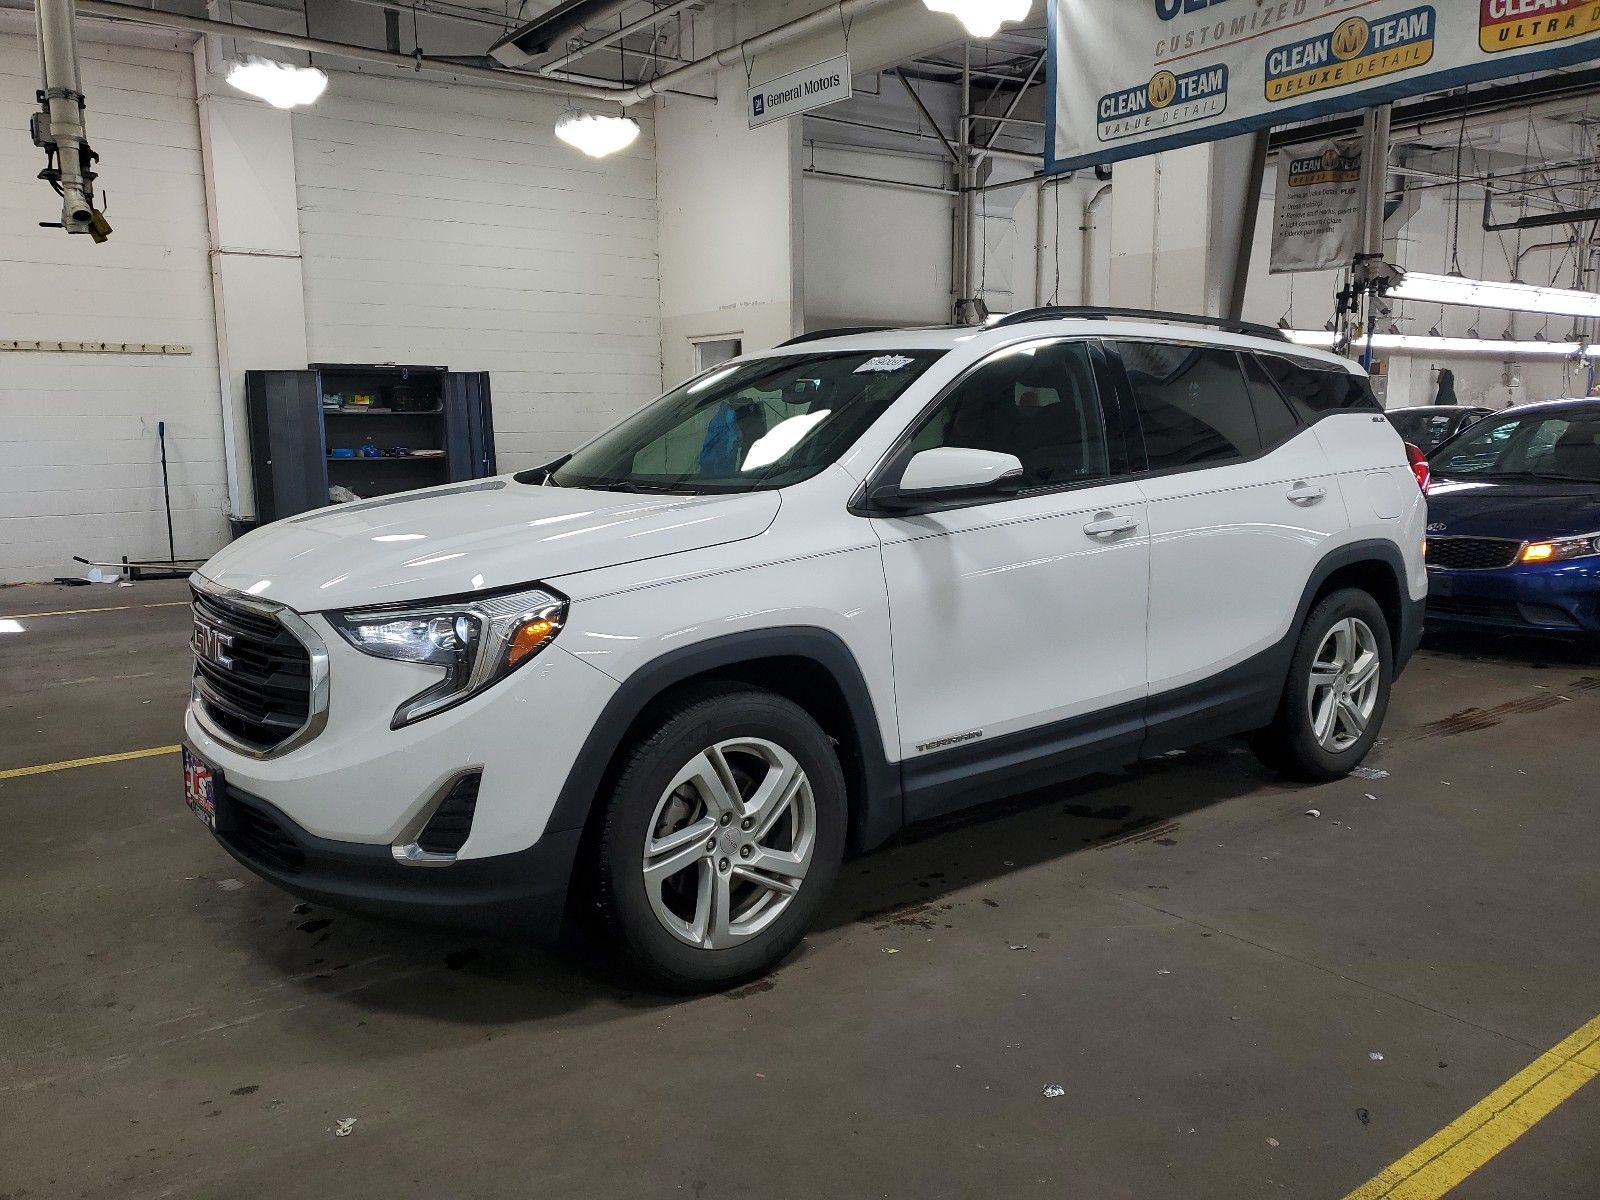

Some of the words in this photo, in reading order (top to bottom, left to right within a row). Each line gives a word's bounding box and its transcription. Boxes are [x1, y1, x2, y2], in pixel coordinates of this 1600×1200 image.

[1489, 0, 1568, 19] CLE
[1155, 0, 1305, 57] CUSTOMIZED
[1269, 39, 1329, 75] CLEAN
[1372, 11, 1429, 48] TEAM
[1499, 14, 1575, 41] ULTRA
[1274, 67, 1344, 95] DELUXE
[1356, 47, 1421, 75] DETAIL
[767, 84, 802, 108] General
[804, 74, 840, 96] Motors
[1100, 89, 1147, 118] CLEAN
[1178, 69, 1223, 98] TEAM
[1105, 116, 1151, 136] VALUE
[1162, 100, 1217, 123] DETAIL
[1291, 159, 1321, 174] CLEAN
[1340, 187, 1356, 195] PLUS
[193, 620, 233, 671] GMC
[915, 728, 983, 752] TERRAIN
